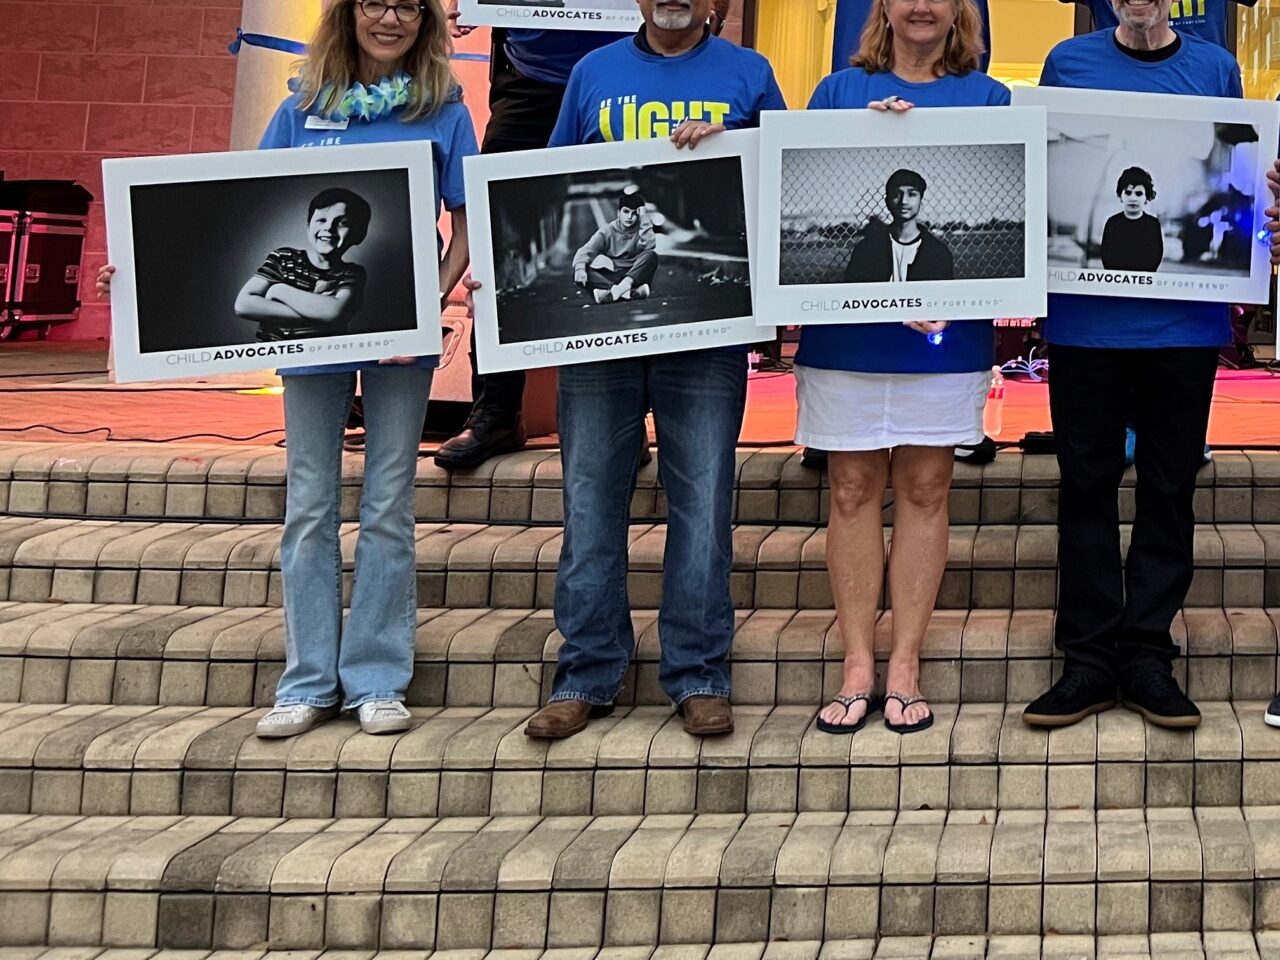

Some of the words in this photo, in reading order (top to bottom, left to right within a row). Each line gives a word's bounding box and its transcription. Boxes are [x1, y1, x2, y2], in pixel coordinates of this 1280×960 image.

[532, 9, 602, 20] ADVOCATES
[618, 94, 637, 104] THE
[320, 137, 341, 146] THE
[1048, 271, 1077, 282] HILD
[1078, 272, 1153, 285] ADVOCATES
[842, 298, 922, 310] ADVOCATES
[565, 333, 648, 351] ADVOCATES
[669, 331, 693, 339] FORT
[213, 343, 304, 361] ADVOCATES
[327, 342, 353, 350] FORT
